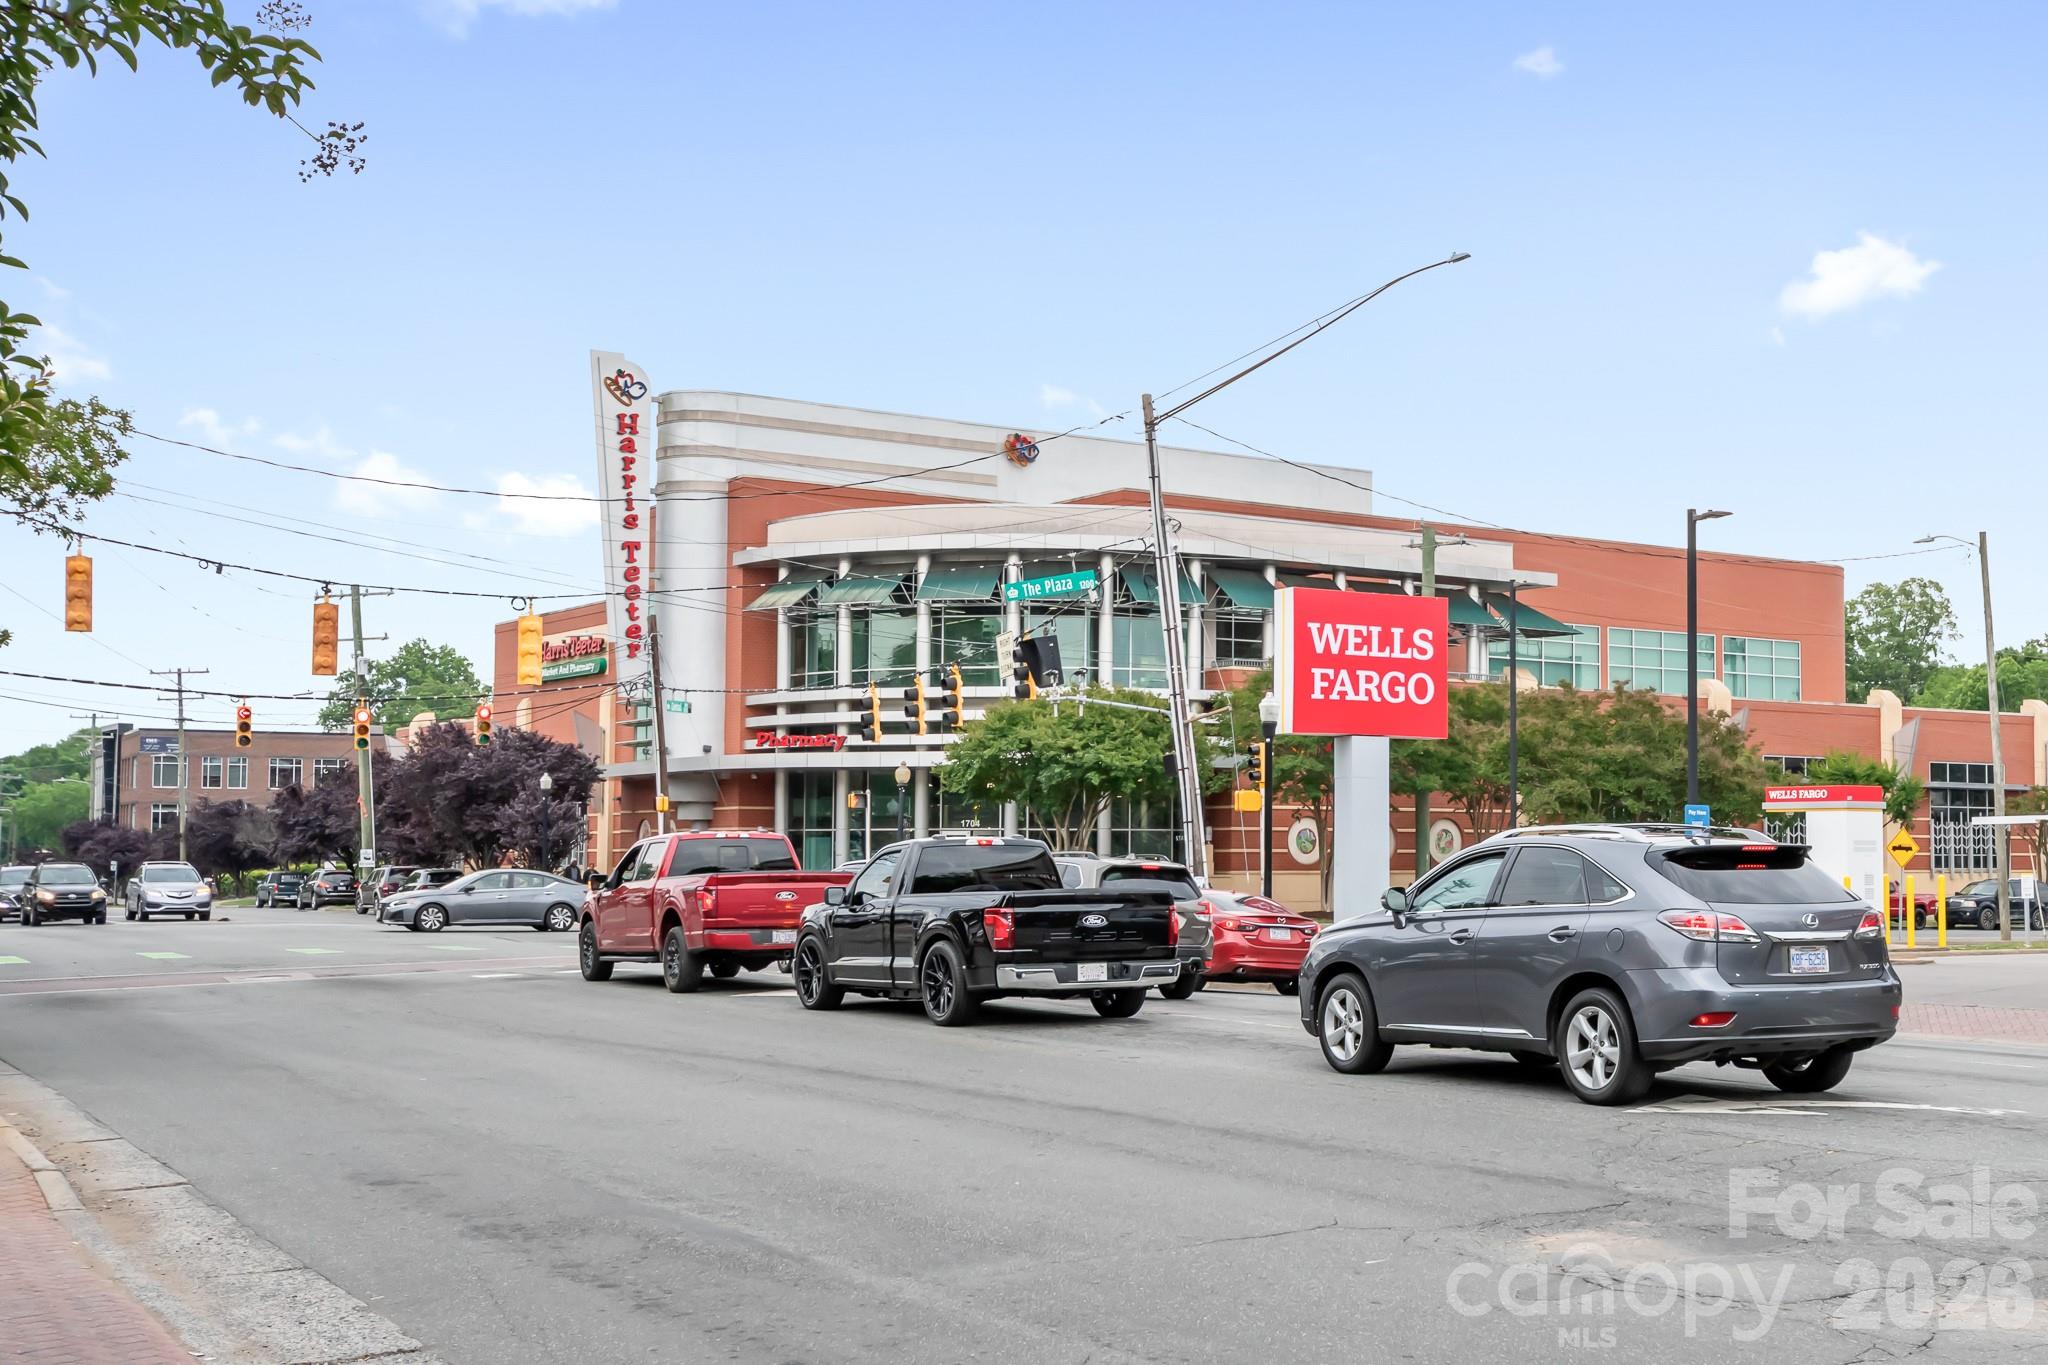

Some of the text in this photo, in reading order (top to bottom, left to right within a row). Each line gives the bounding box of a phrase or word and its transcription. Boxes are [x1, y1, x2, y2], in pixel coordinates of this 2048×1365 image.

[616, 413, 642, 658] Harris Teeter
[1022, 583, 1042, 597] The
[1044, 578, 1073, 594] Plaza
[570, 636, 604, 657] Teeter
[1307, 622, 1434, 660] WELLS
[1311, 668, 1435, 705] FARGO
[756, 732, 847, 752] Pharmacy
[1769, 789, 1828, 799] WELLS FARGO
[961, 819, 981, 828] 1704
